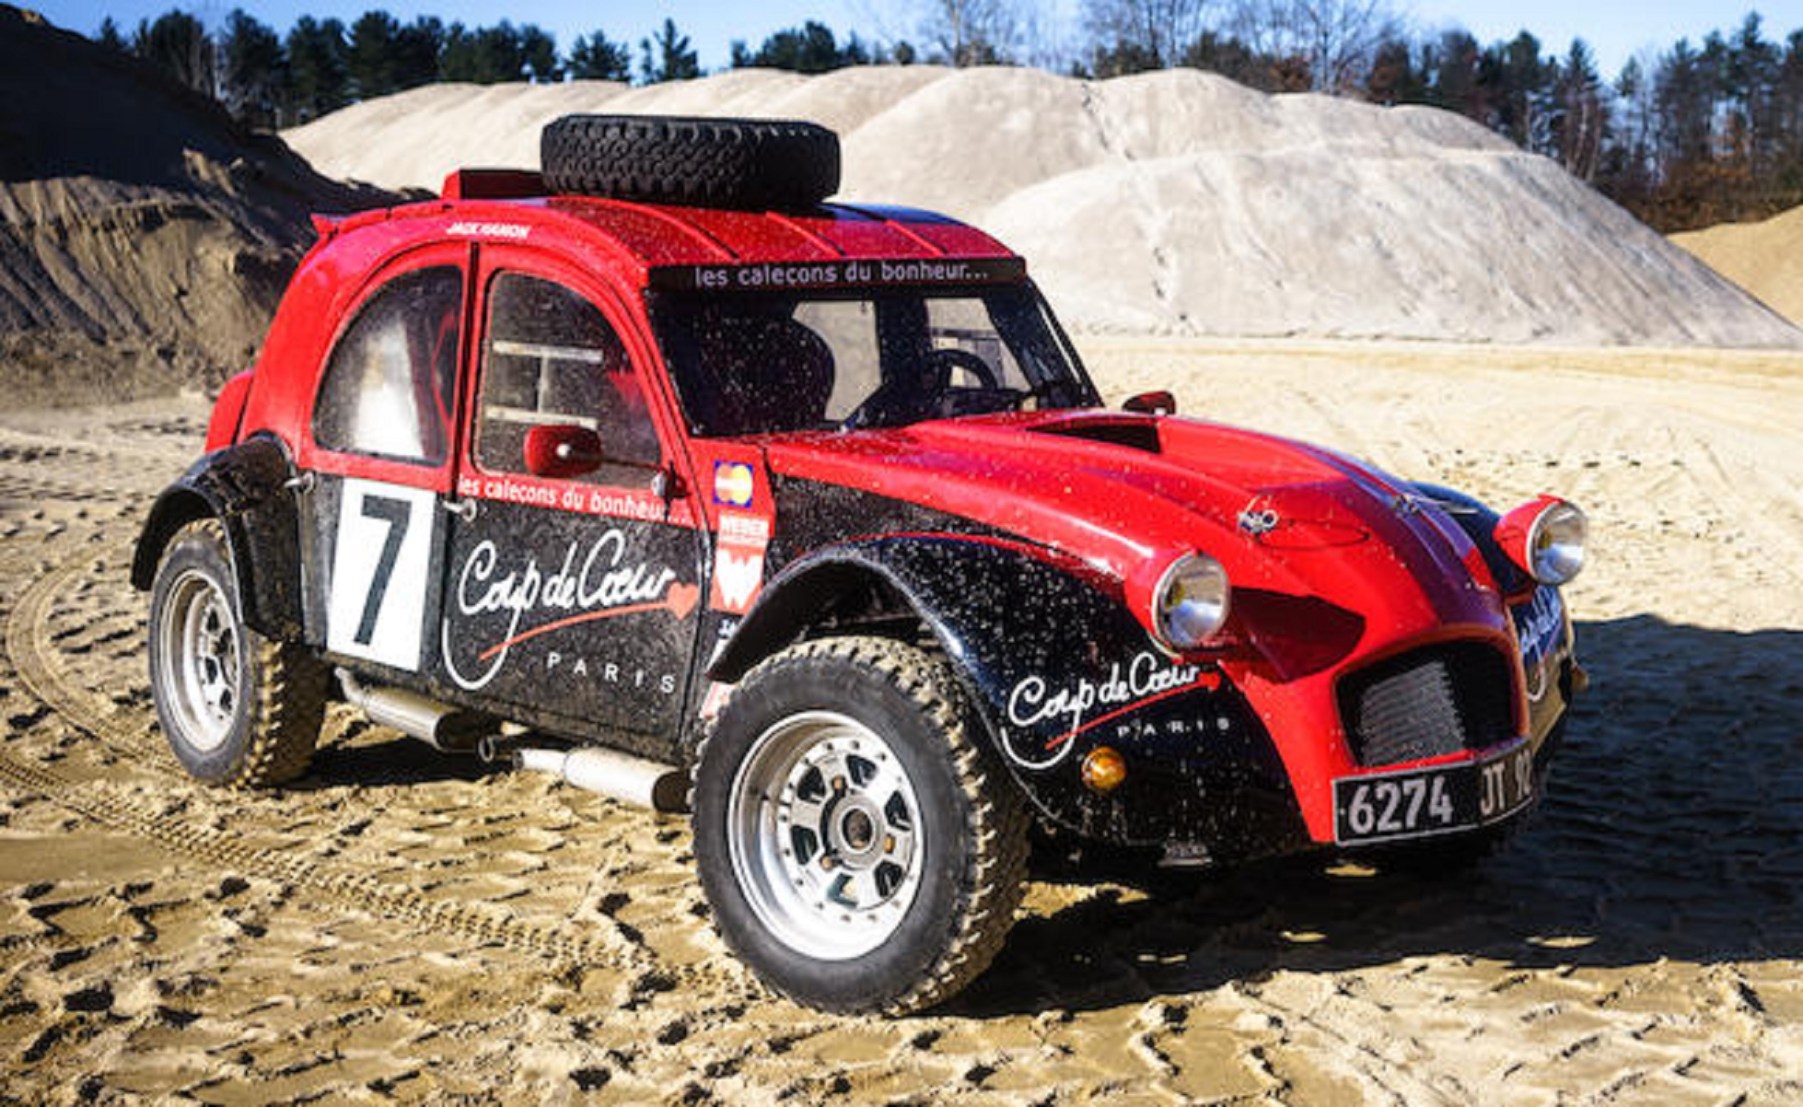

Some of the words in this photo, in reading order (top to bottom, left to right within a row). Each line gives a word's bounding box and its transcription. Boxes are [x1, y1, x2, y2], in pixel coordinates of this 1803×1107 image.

[695, 267, 728, 287] les
[738, 264, 837, 288] caleçons
[845, 262, 872, 281] du
[457, 475, 479, 496] les
[562, 485, 584, 511] du
[354, 494, 412, 646] 7
[542, 541, 577, 608] de
[547, 651, 675, 693] PARIS
[1100, 663, 1130, 702] de
[1117, 716, 1230, 738] PARIS
[1350, 775, 1453, 834] 6274
[1480, 762, 1506, 815] JT
[1515, 749, 1532, 801] 92
